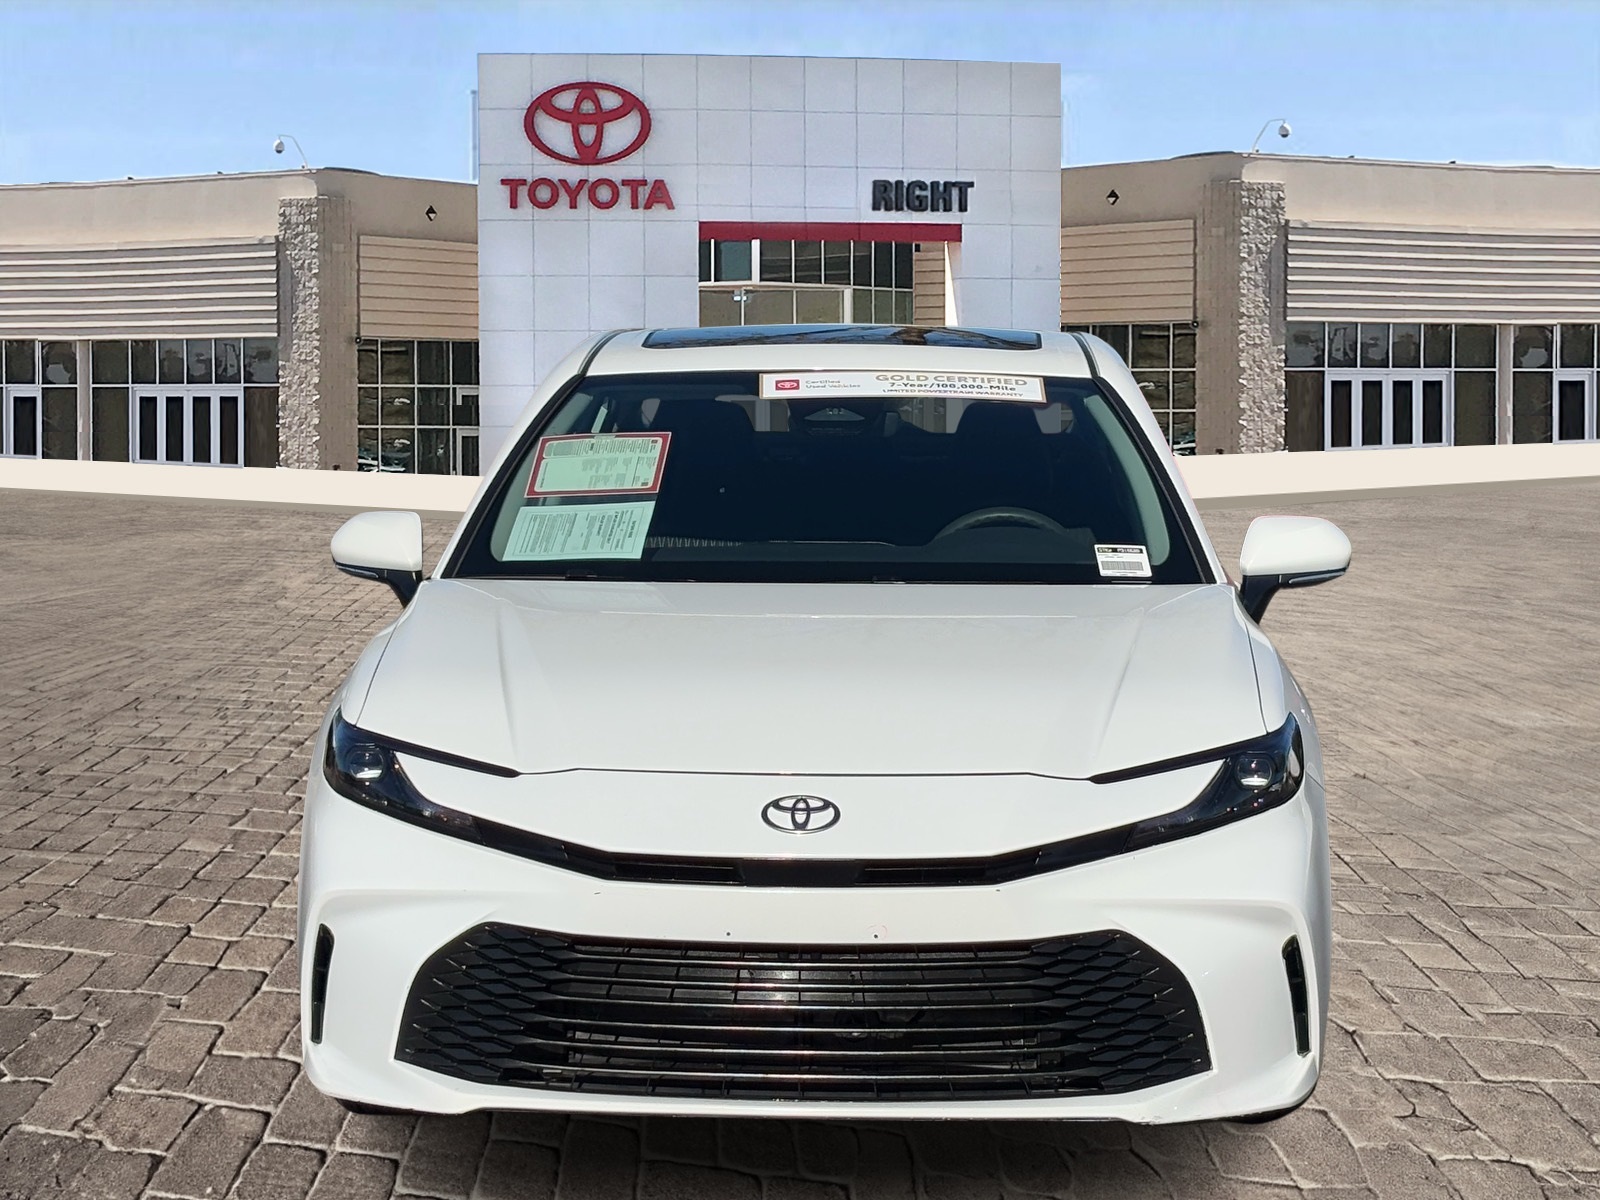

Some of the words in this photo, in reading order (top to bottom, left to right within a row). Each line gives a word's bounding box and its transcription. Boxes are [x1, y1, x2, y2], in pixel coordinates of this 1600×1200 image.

[500, 177, 675, 210] TOYOTA
[872, 179, 974, 212] RIGHT
[875, 374, 929, 382] GOLD
[933, 375, 1027, 386] CERTIFIED
[889, 382, 1016, 392] 7-Year/100,000-Mile
